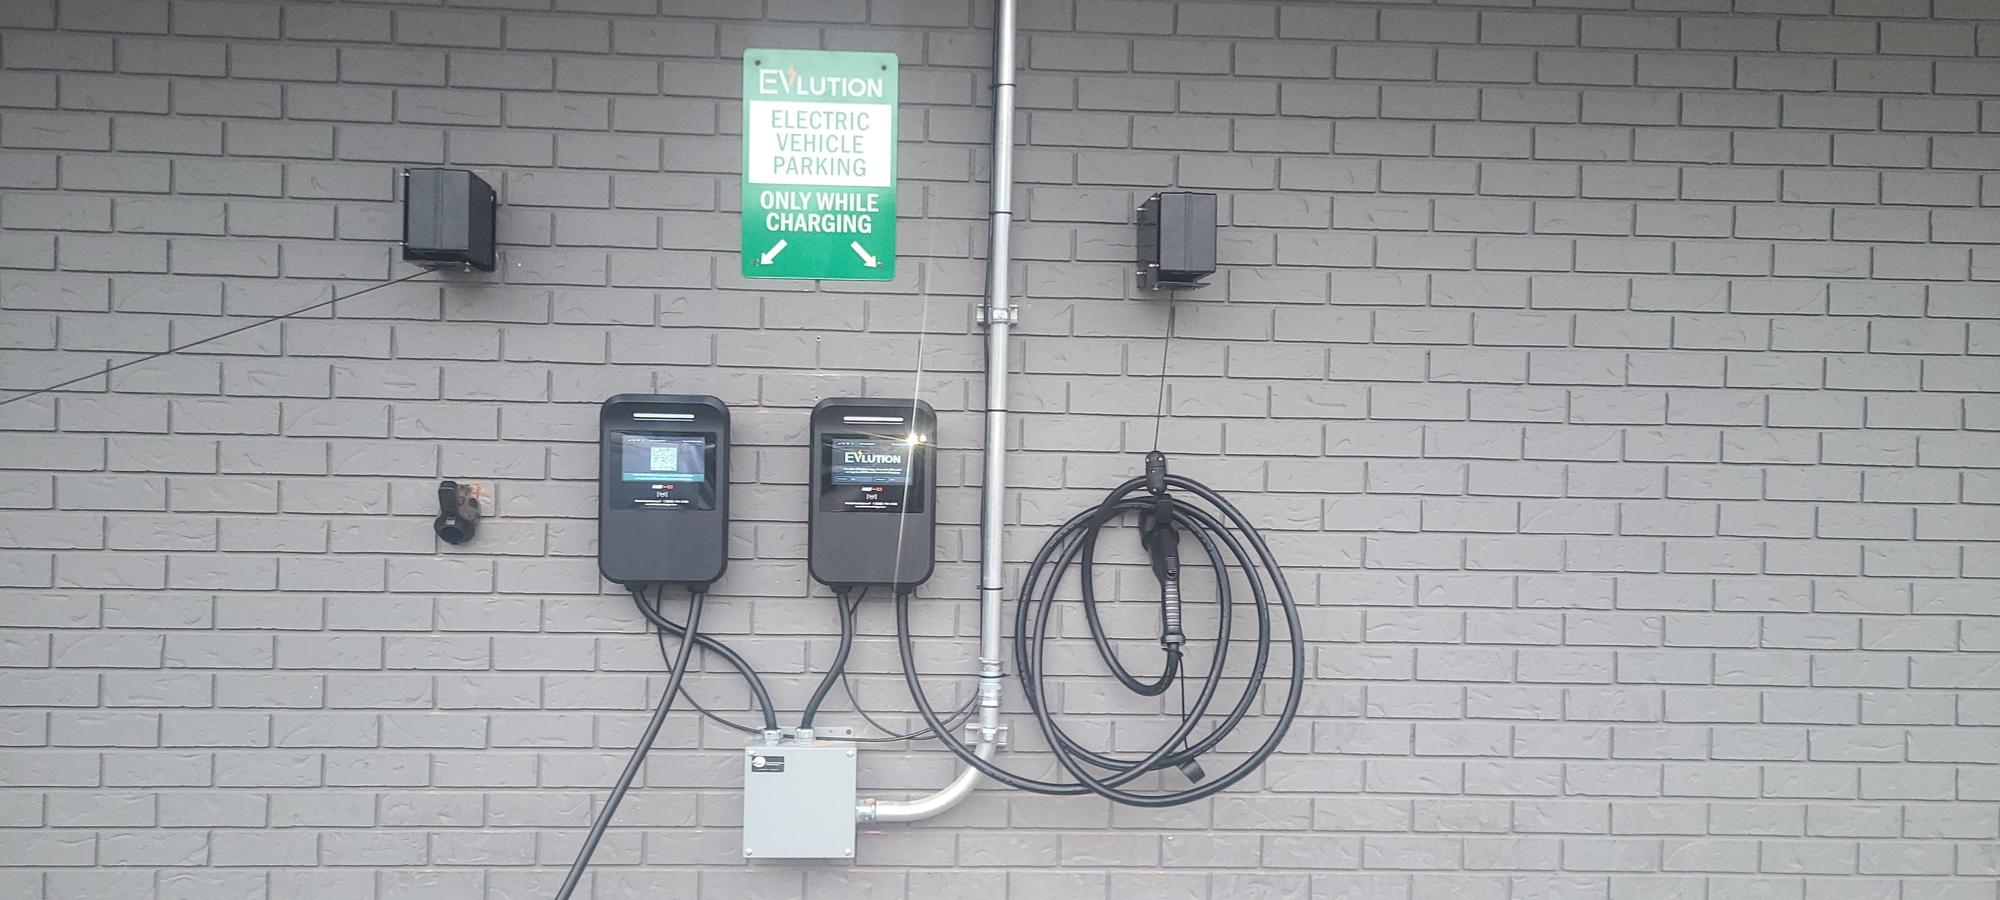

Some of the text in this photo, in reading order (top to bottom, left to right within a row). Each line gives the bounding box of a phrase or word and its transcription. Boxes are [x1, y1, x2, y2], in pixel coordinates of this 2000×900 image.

[772, 109, 870, 131] ELECTRIC
[776, 133, 864, 154] VEHICLE
[773, 156, 867, 177] PARKING
[760, 190, 880, 213] ONLY WHILE
[766, 212, 872, 234] CHARGING
